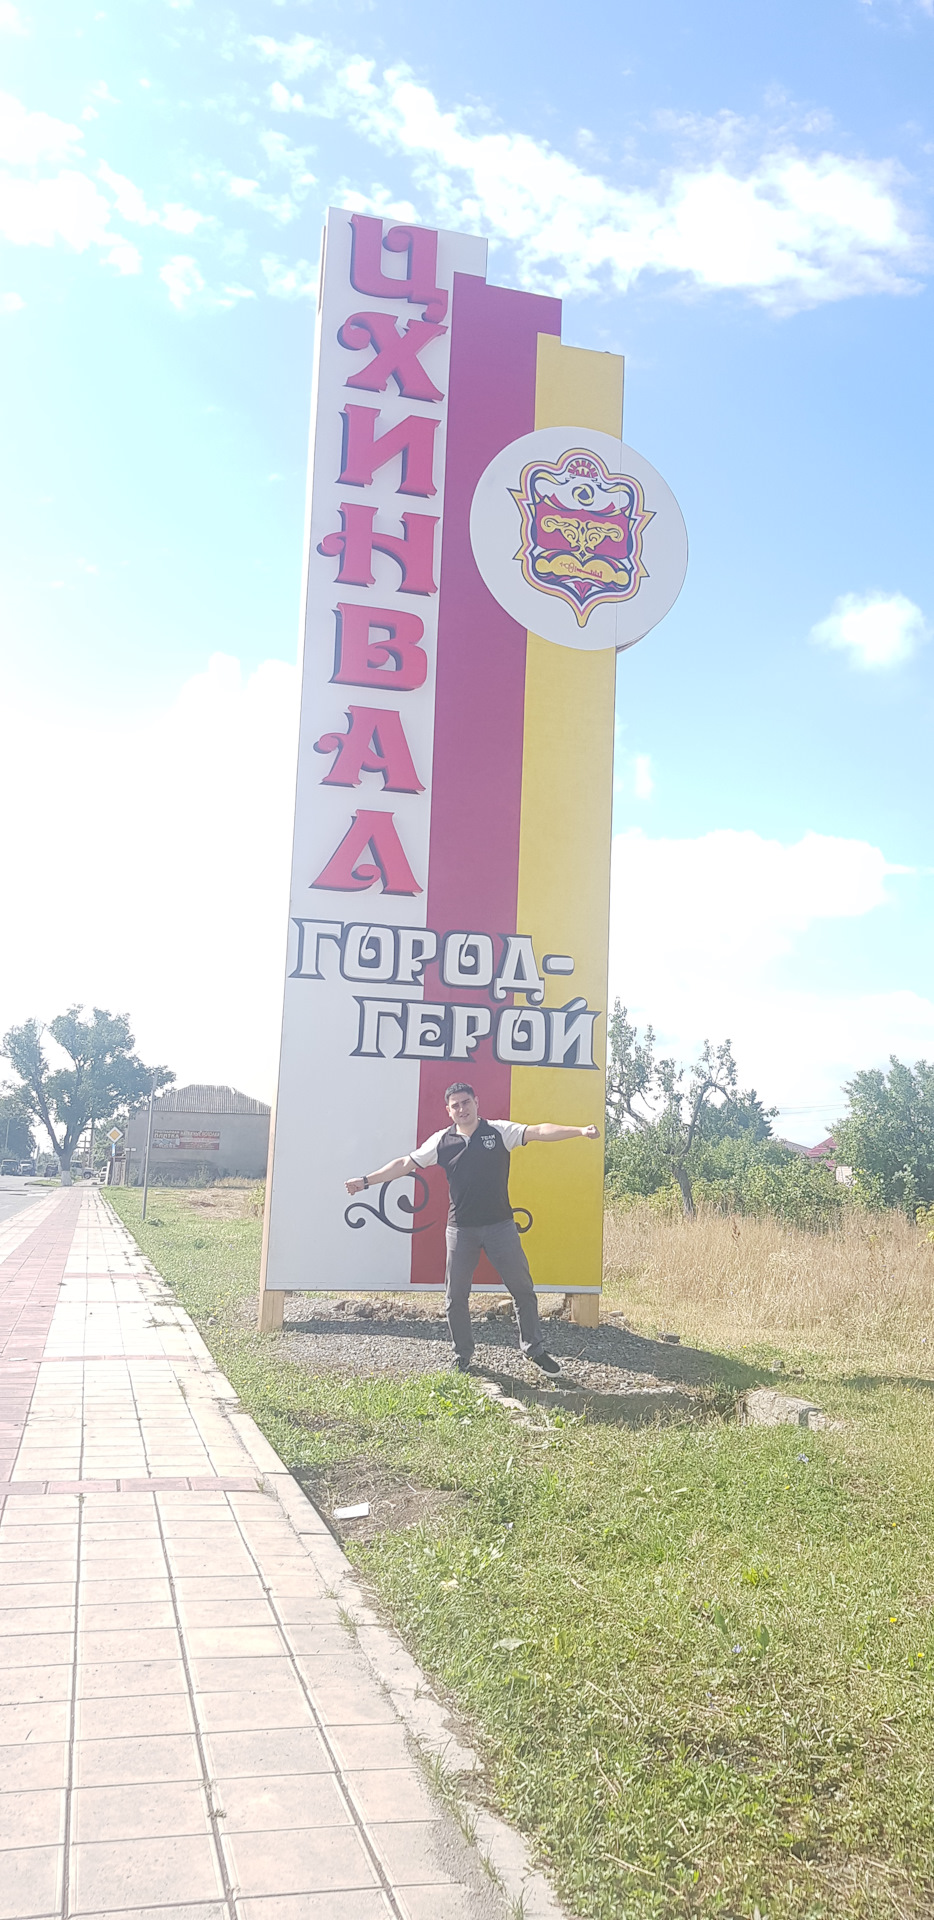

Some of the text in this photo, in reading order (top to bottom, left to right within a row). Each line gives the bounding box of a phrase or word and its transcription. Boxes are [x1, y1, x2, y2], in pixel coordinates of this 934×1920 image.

[309, 214, 449, 897] ЦХИНВАЛ
[289, 918, 575, 1004] ГОРОД-
[349, 996, 602, 1070] ГЕРОЙ
